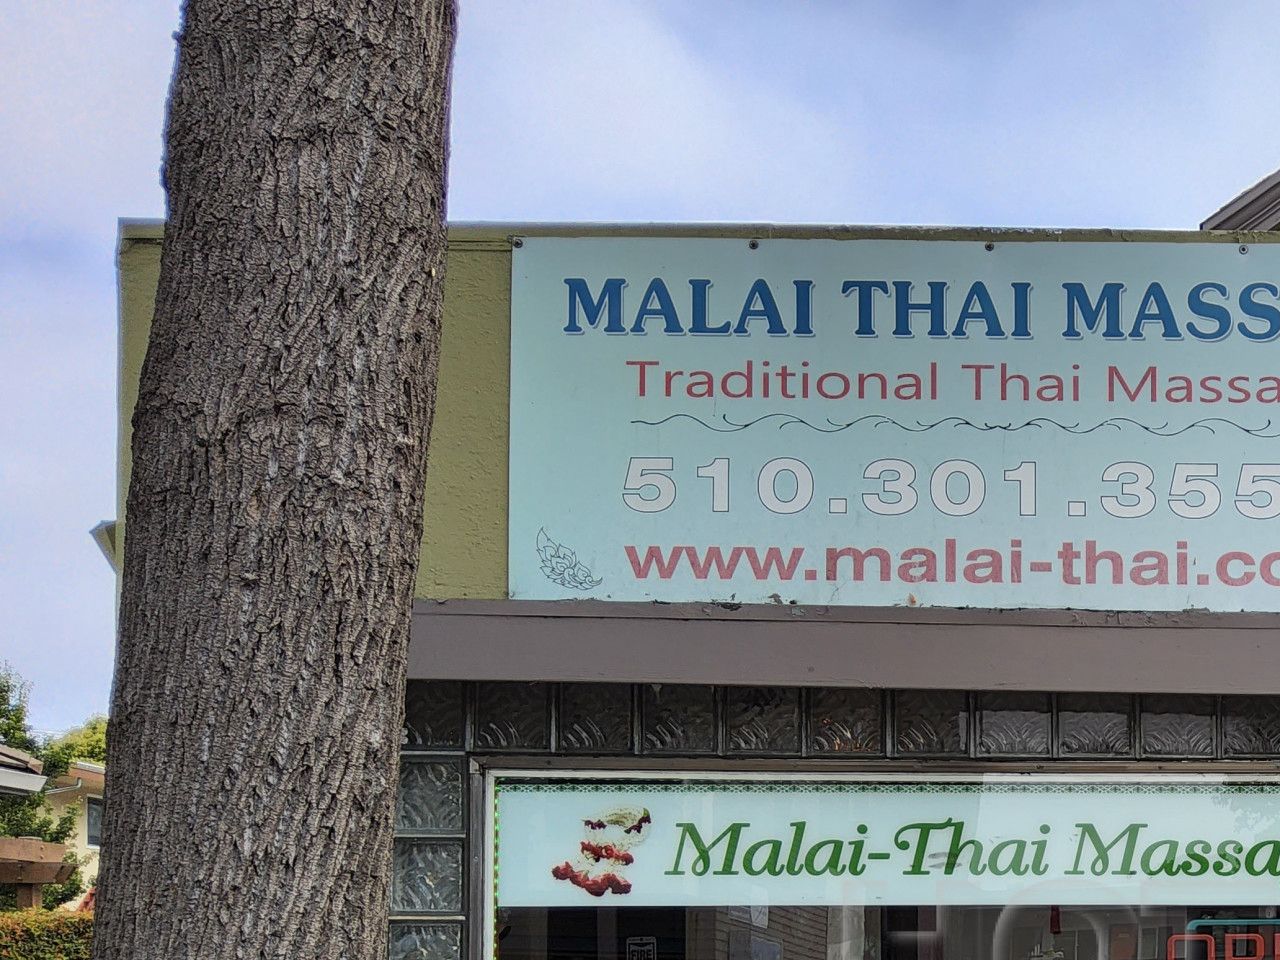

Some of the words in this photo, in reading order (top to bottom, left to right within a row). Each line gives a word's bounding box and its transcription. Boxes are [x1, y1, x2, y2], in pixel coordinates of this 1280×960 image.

[564, 277, 815, 337] MALAI
[842, 280, 1033, 340] THAI
[626, 360, 938, 401] Traditional
[962, 364, 1081, 402] Thai
[665, 818, 1048, 878] Malai-Thai
[630, 949, 653, 960] FIRE
